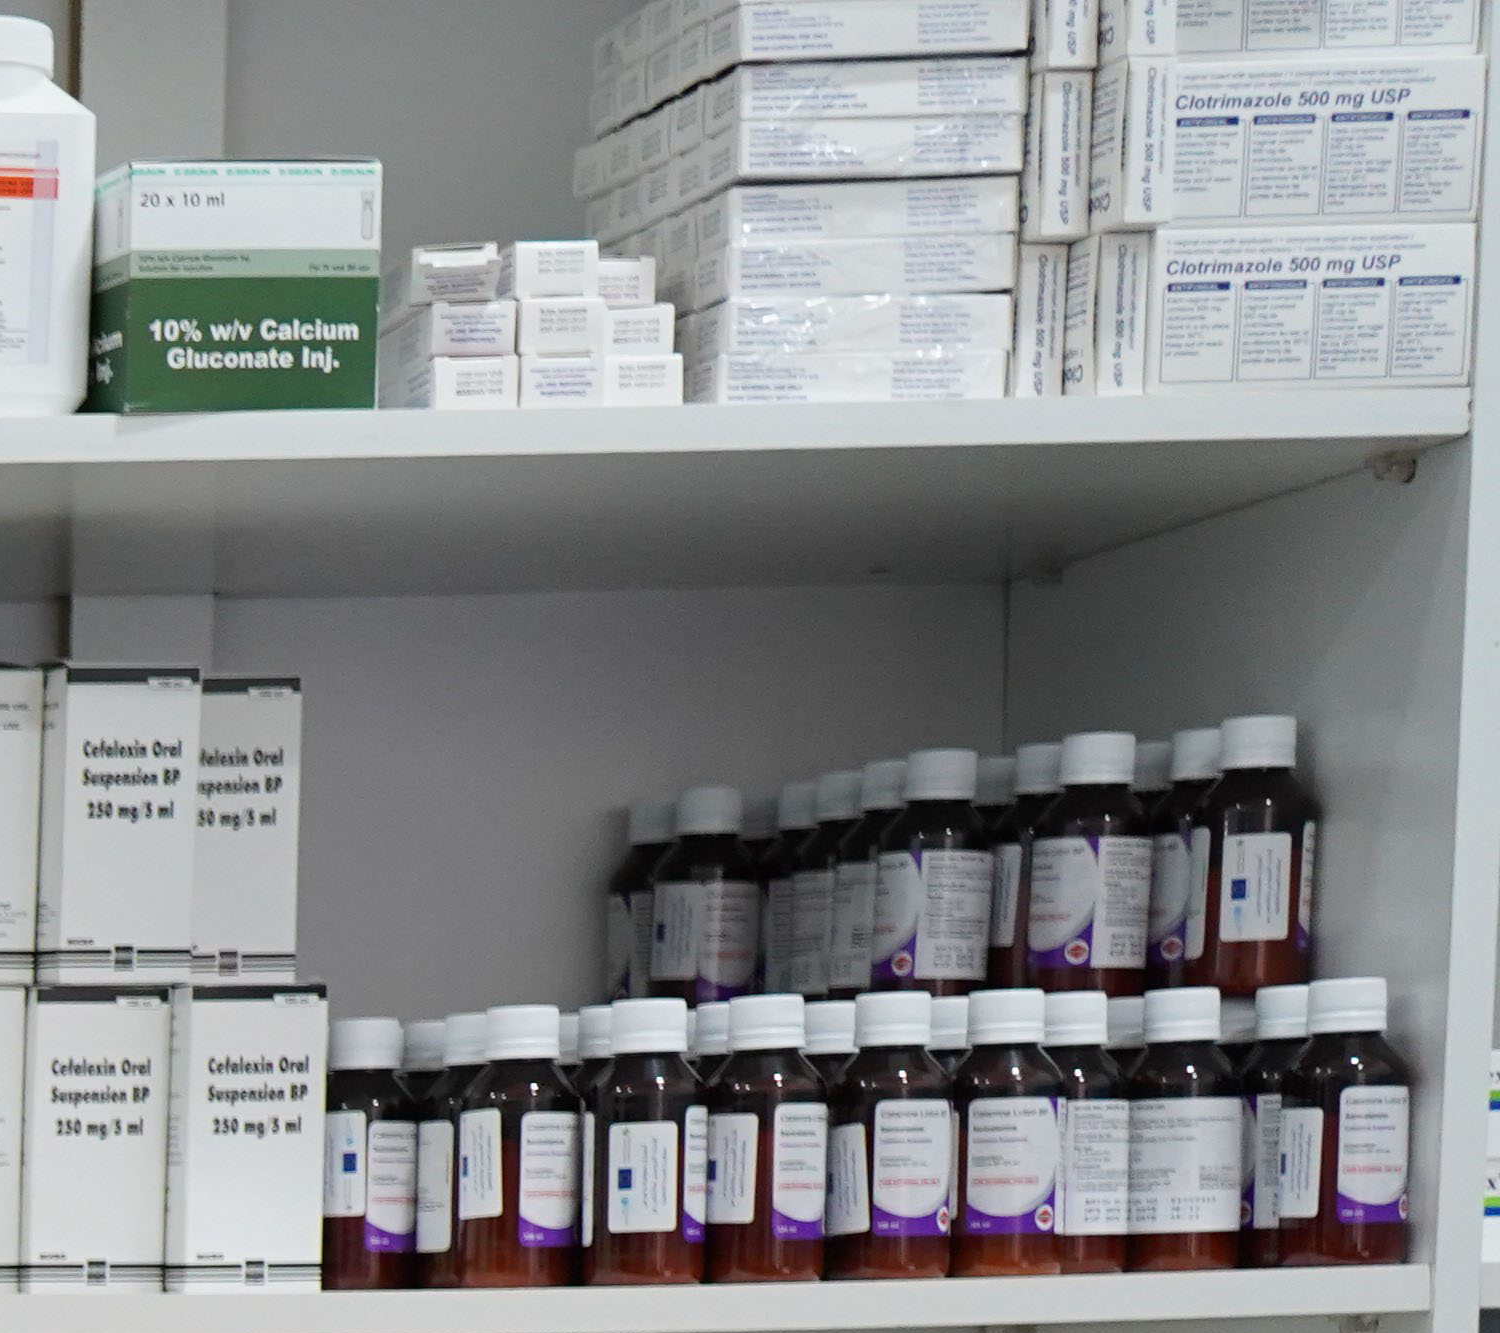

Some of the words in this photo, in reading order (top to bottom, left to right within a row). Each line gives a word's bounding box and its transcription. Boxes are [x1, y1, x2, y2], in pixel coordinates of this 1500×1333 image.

[1176, 92, 1292, 110] Clotrimazole
[1298, 90, 1330, 106] 500
[1335, 92, 1364, 108] mg
[1371, 88, 1411, 104] USP
[140, 193, 160, 208] 20
[166, 196, 174, 207] x
[183, 193, 200, 208] 10
[207, 192, 225, 207] ml
[1166, 258, 1282, 276] Clotrimazole
[1289, 256, 1320, 273] 500
[1326, 258, 1355, 274] mg
[1362, 254, 1402, 270] USP
[149, 318, 202, 342] 10%
[210, 318, 253, 341] w/v
[260, 318, 359, 341] Calcium
[166, 346, 293, 370] Gluconate
[302, 346, 340, 373] Inj.
[82, 738, 149, 760] Cefalexin
[152, 738, 183, 759] Oral
[82, 767, 157, 790] Suspension
[162, 767, 181, 786] BP
[50, 1055, 116, 1079] Cefalexin
[120, 1055, 151, 1077] Oral
[50, 1084, 126, 1108] Suspension
[131, 1085, 150, 1104] BP
